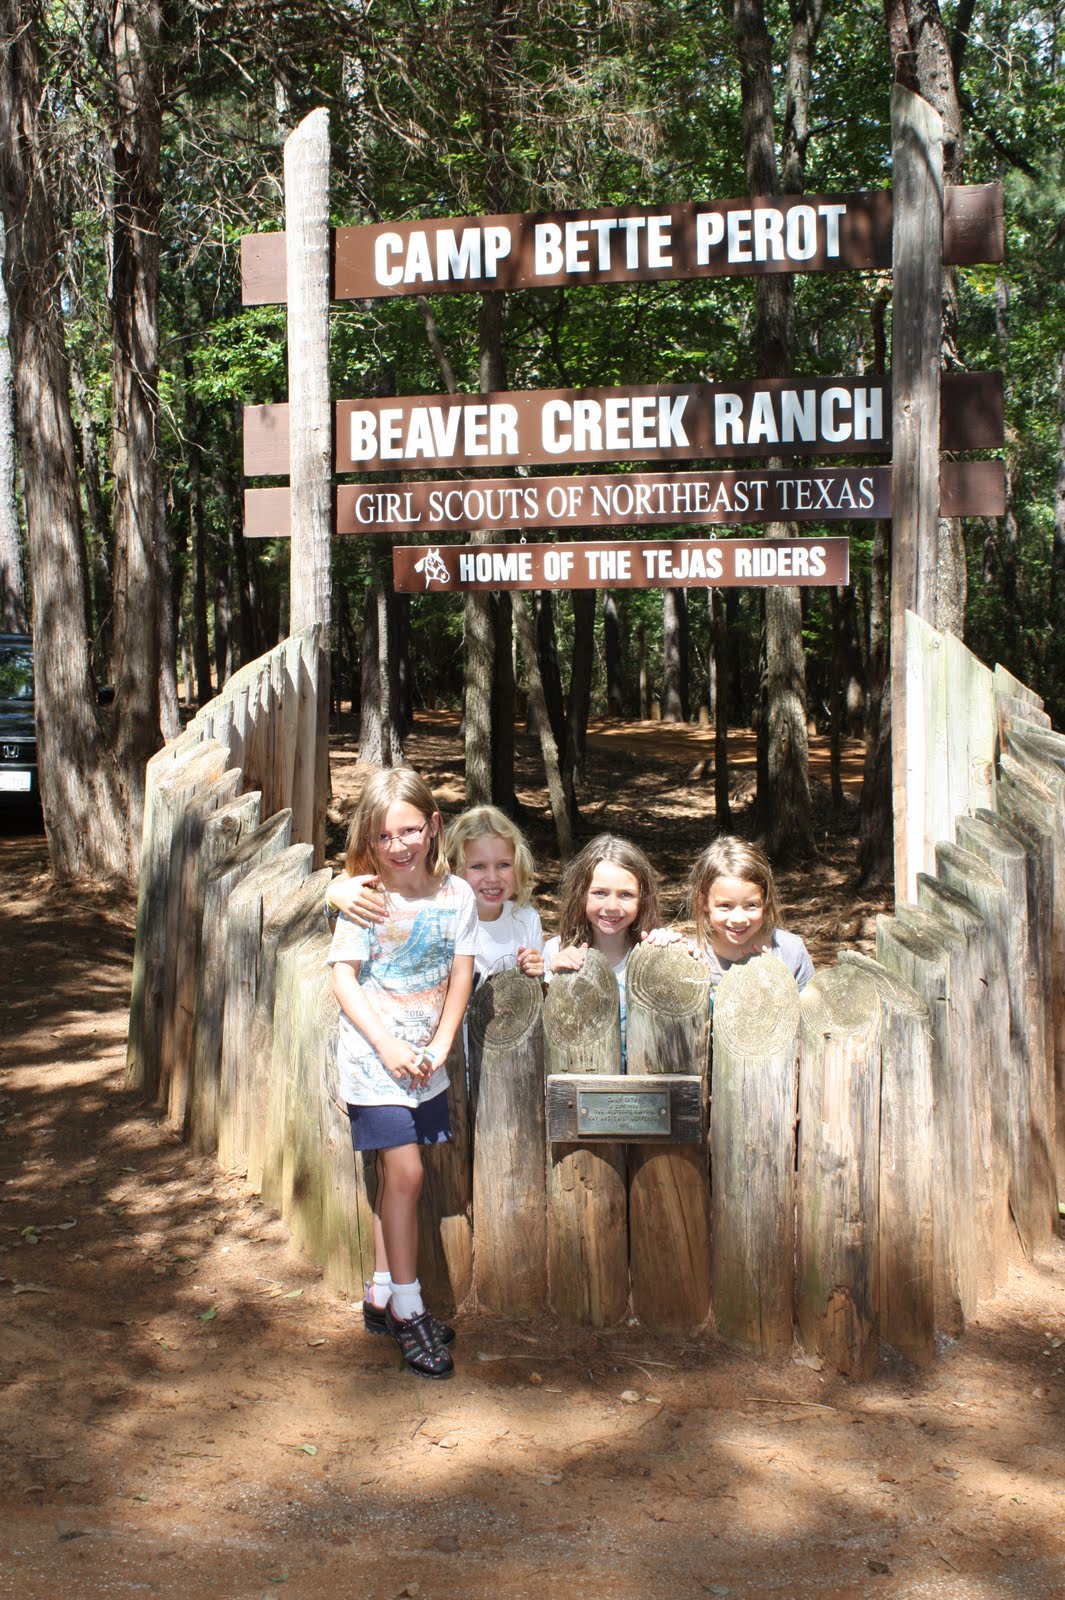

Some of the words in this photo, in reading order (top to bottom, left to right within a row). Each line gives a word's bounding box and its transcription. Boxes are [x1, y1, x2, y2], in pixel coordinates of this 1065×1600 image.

[374, 227, 511, 286] CAMP
[534, 216, 672, 275] BETTE
[697, 204, 846, 265] PEROT
[351, 404, 519, 461] BEAVER
[542, 395, 690, 453] CREEK
[715, 387, 883, 445] RANCH
[355, 492, 421, 524] GIRL
[429, 487, 539, 522] SCOUTS
[546, 486, 583, 518] OF
[590, 480, 768, 516] NORTHEAST
[776, 477, 874, 510] TEXAS
[460, 552, 532, 582] HOME
[543, 551, 574, 581] OF
[585, 550, 631, 580] THE
[643, 547, 723, 579] TEJAS
[735, 546, 826, 577] RIDERS
[403, 1009, 425, 1017] 2010
